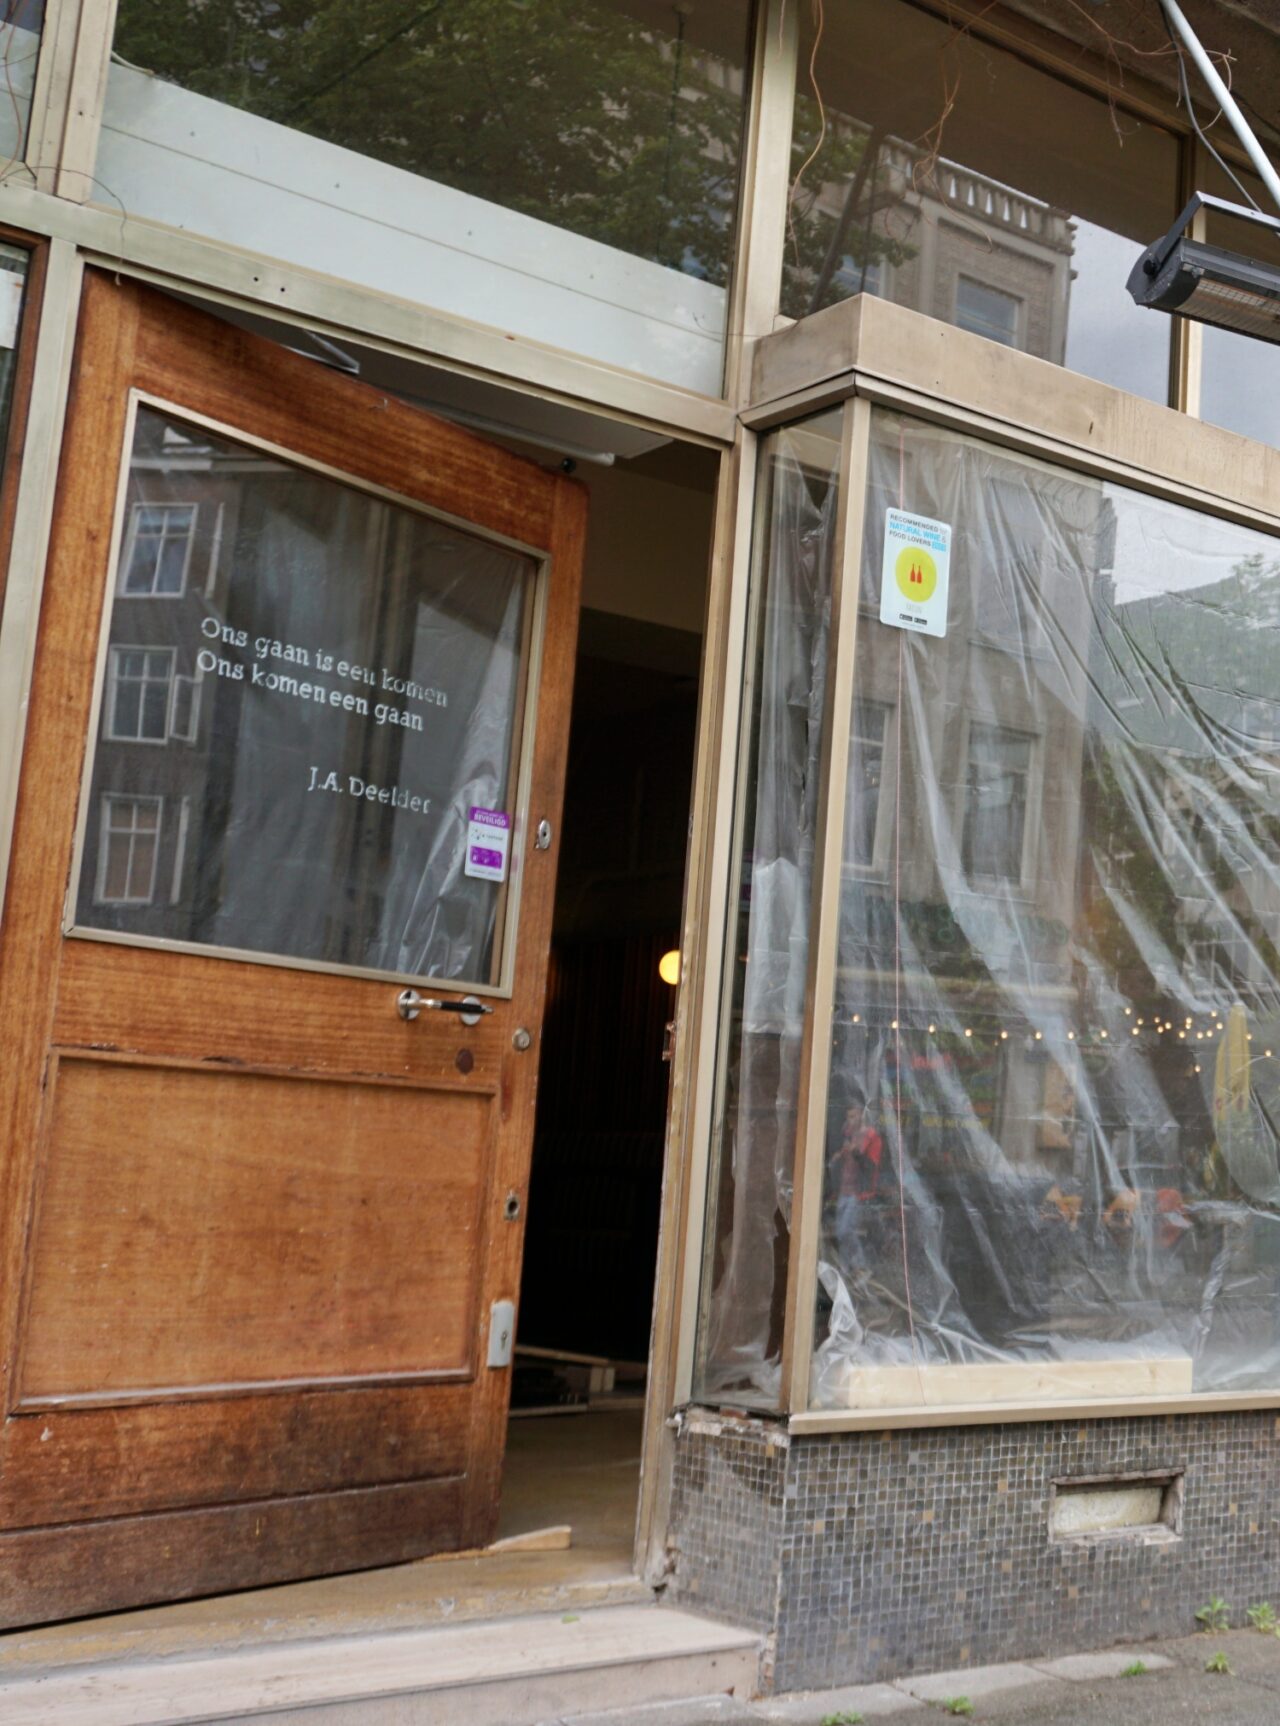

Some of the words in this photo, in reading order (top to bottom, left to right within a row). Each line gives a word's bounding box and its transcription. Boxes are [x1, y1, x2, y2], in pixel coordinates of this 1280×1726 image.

[889, 521, 922, 537] NATURAL
[889, 530, 907, 540] FOOD
[907, 536, 932, 547] LOVERS
[890, 513, 939, 533] RECOMMENDED
[201, 617, 248, 647] Ons
[255, 636, 309, 666] gaan
[316, 649, 334, 672] is
[382, 668, 448, 707] komen
[197, 650, 244, 680] Ons
[251, 663, 326, 703] komen
[329, 690, 368, 715] een
[374, 702, 424, 731] gaan
[307, 766, 343, 793] J.A.
[349, 776, 431, 815] Deelder
